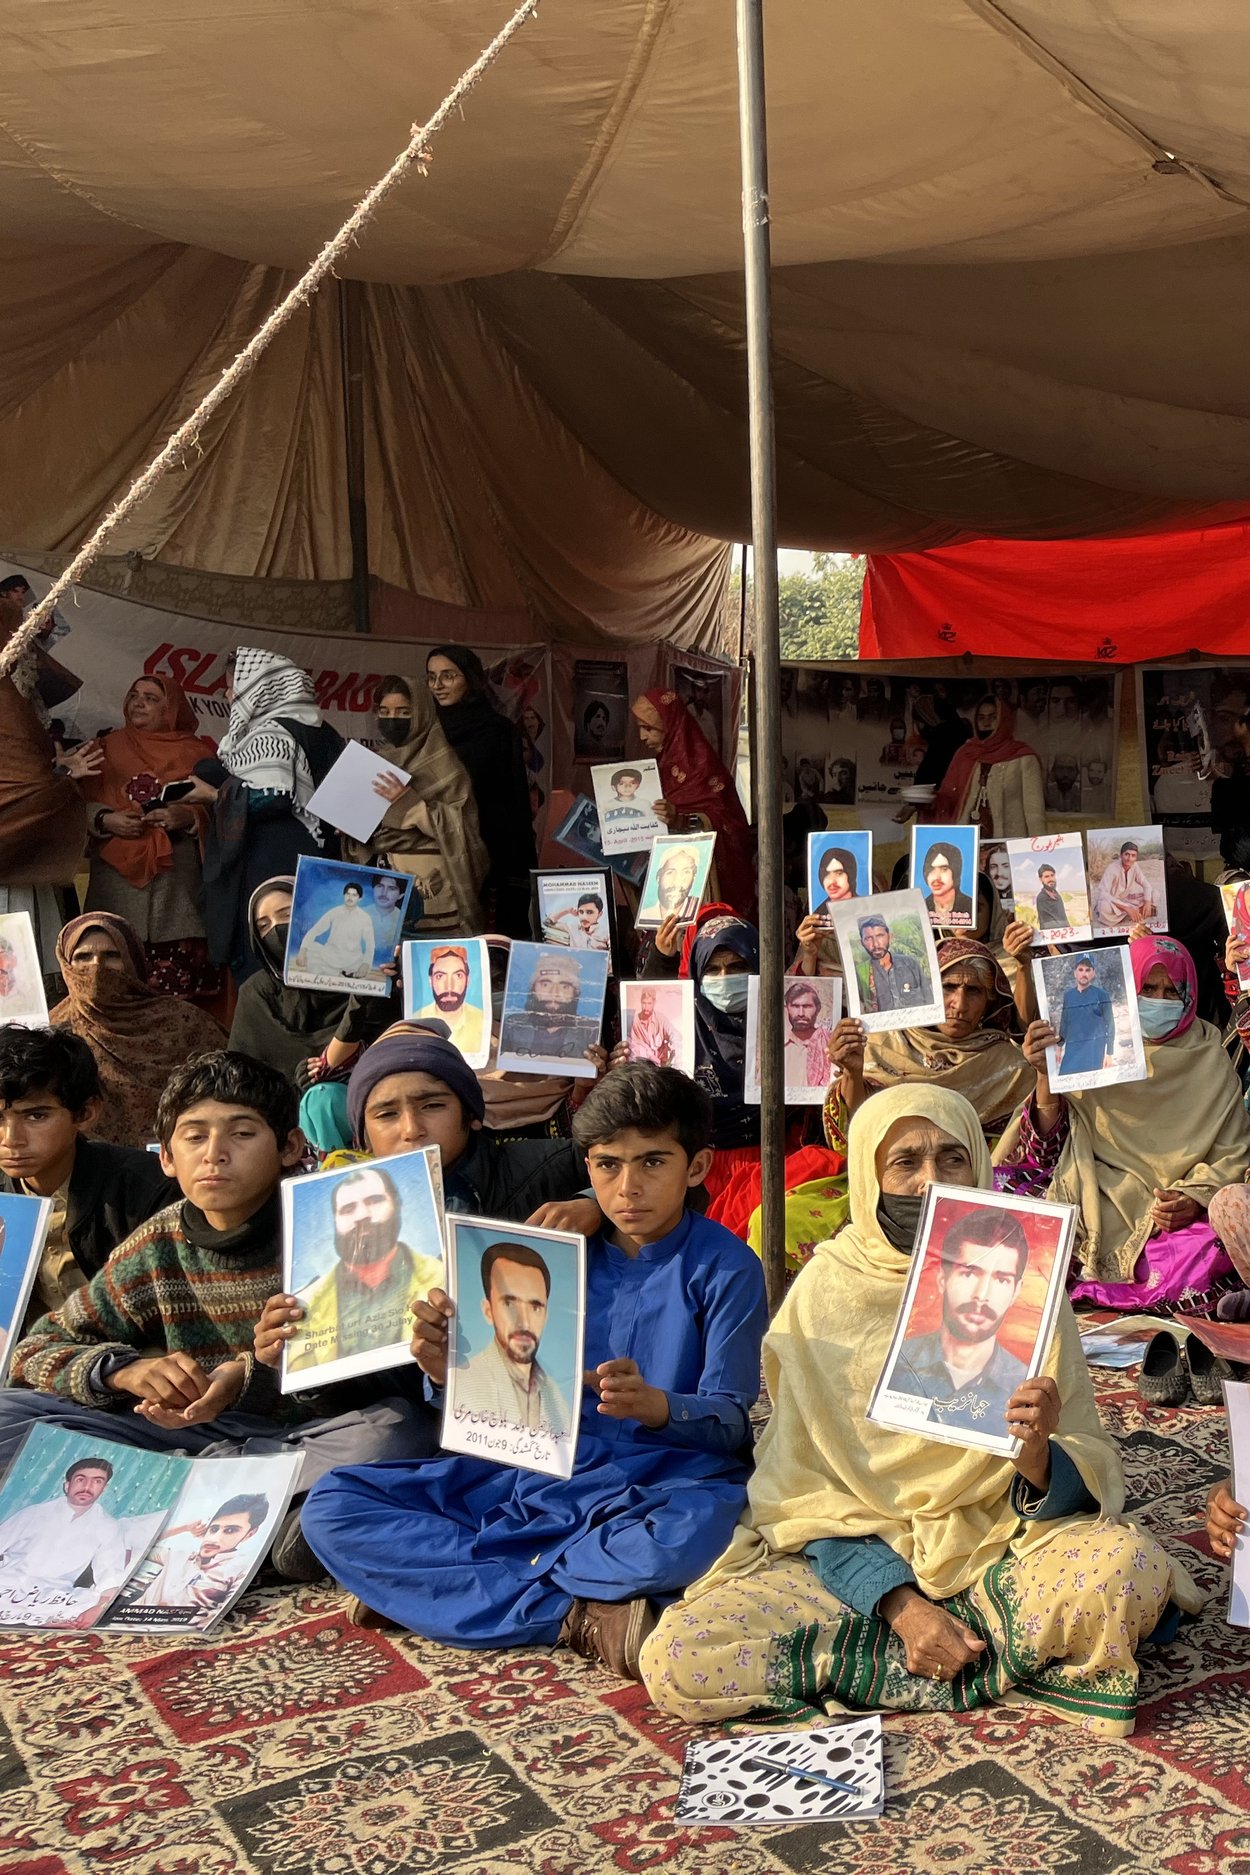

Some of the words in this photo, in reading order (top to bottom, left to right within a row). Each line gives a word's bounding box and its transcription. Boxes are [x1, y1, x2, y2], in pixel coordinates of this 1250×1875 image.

[143, 642, 387, 713] ISLBAD
[365, 1313, 386, 1324] Aziz
[304, 1339, 329, 1352] Date
[330, 1328, 369, 1345] Mssing
